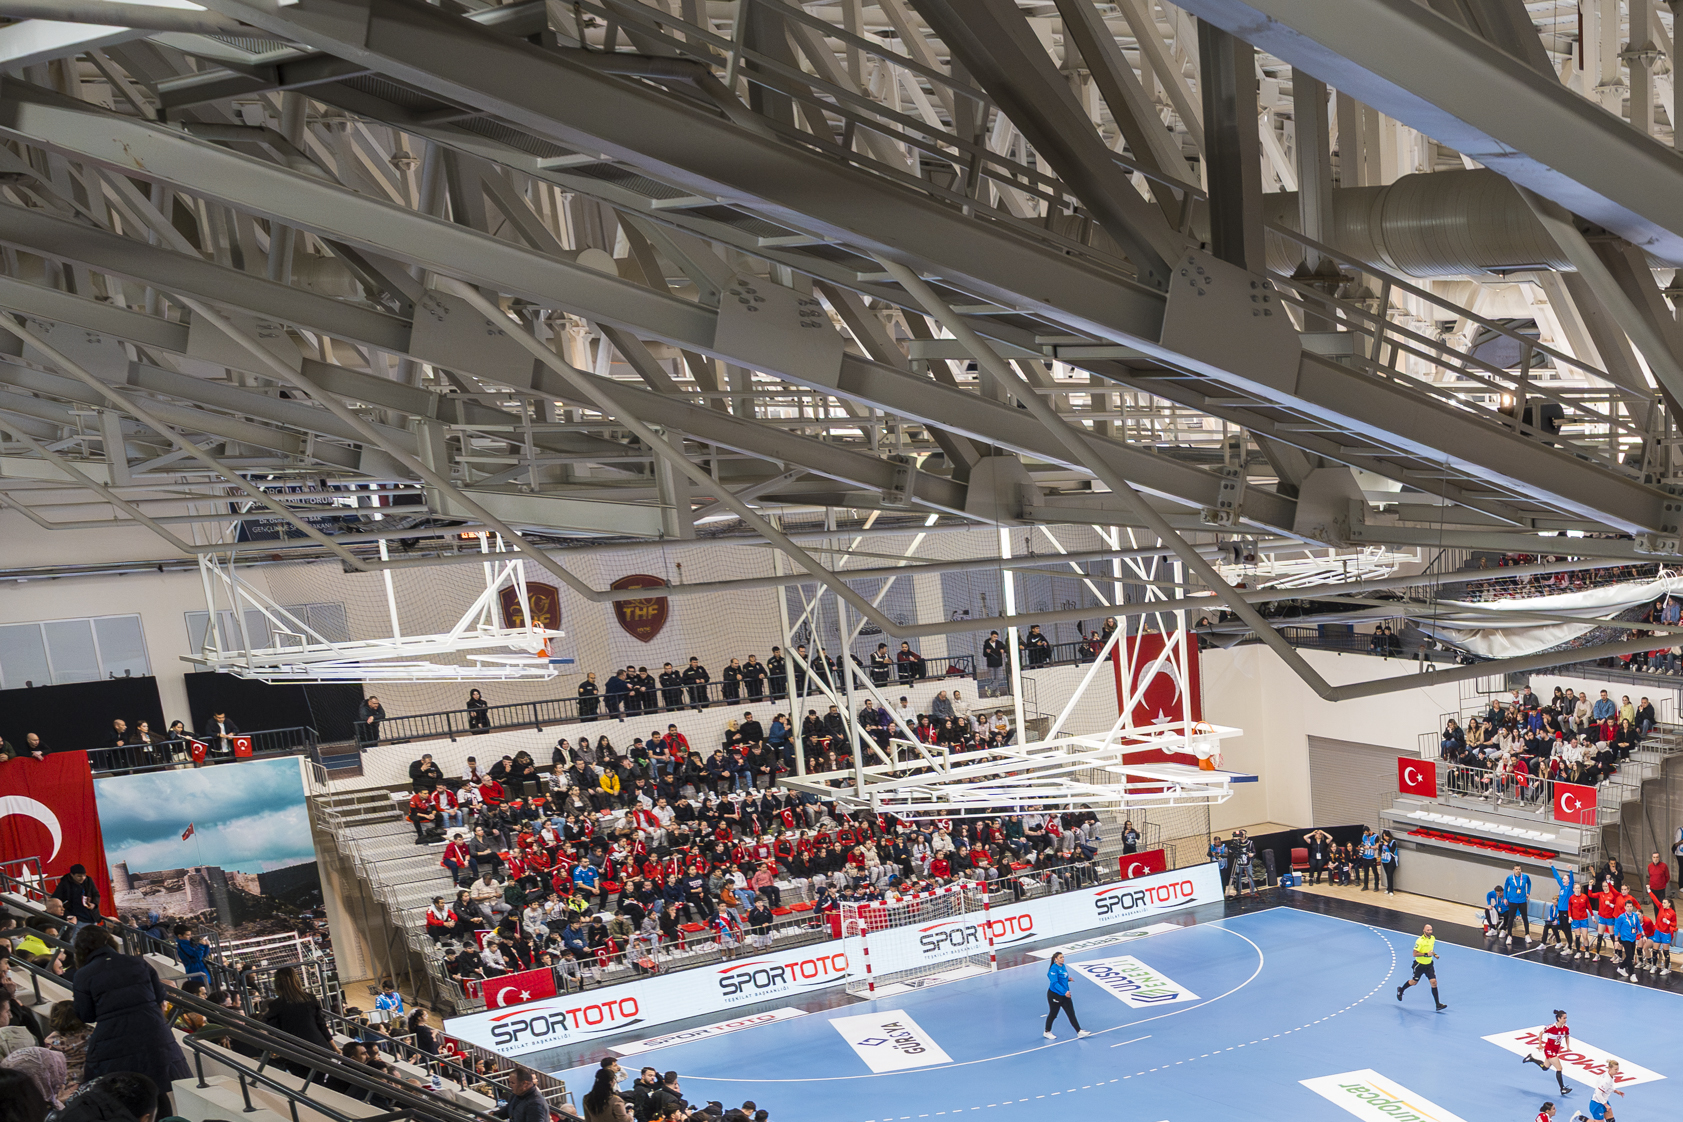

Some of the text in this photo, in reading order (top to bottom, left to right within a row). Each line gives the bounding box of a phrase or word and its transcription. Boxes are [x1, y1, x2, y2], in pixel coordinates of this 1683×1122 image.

[622, 604, 660, 622] THF
[1094, 879, 1194, 916] SPORTOTO
[920, 913, 1033, 954] SPORTOTO
[718, 952, 849, 997] SPORTOTO
[1078, 962, 1142, 993] ULUSOY
[490, 996, 640, 1046] SPORTOTO
